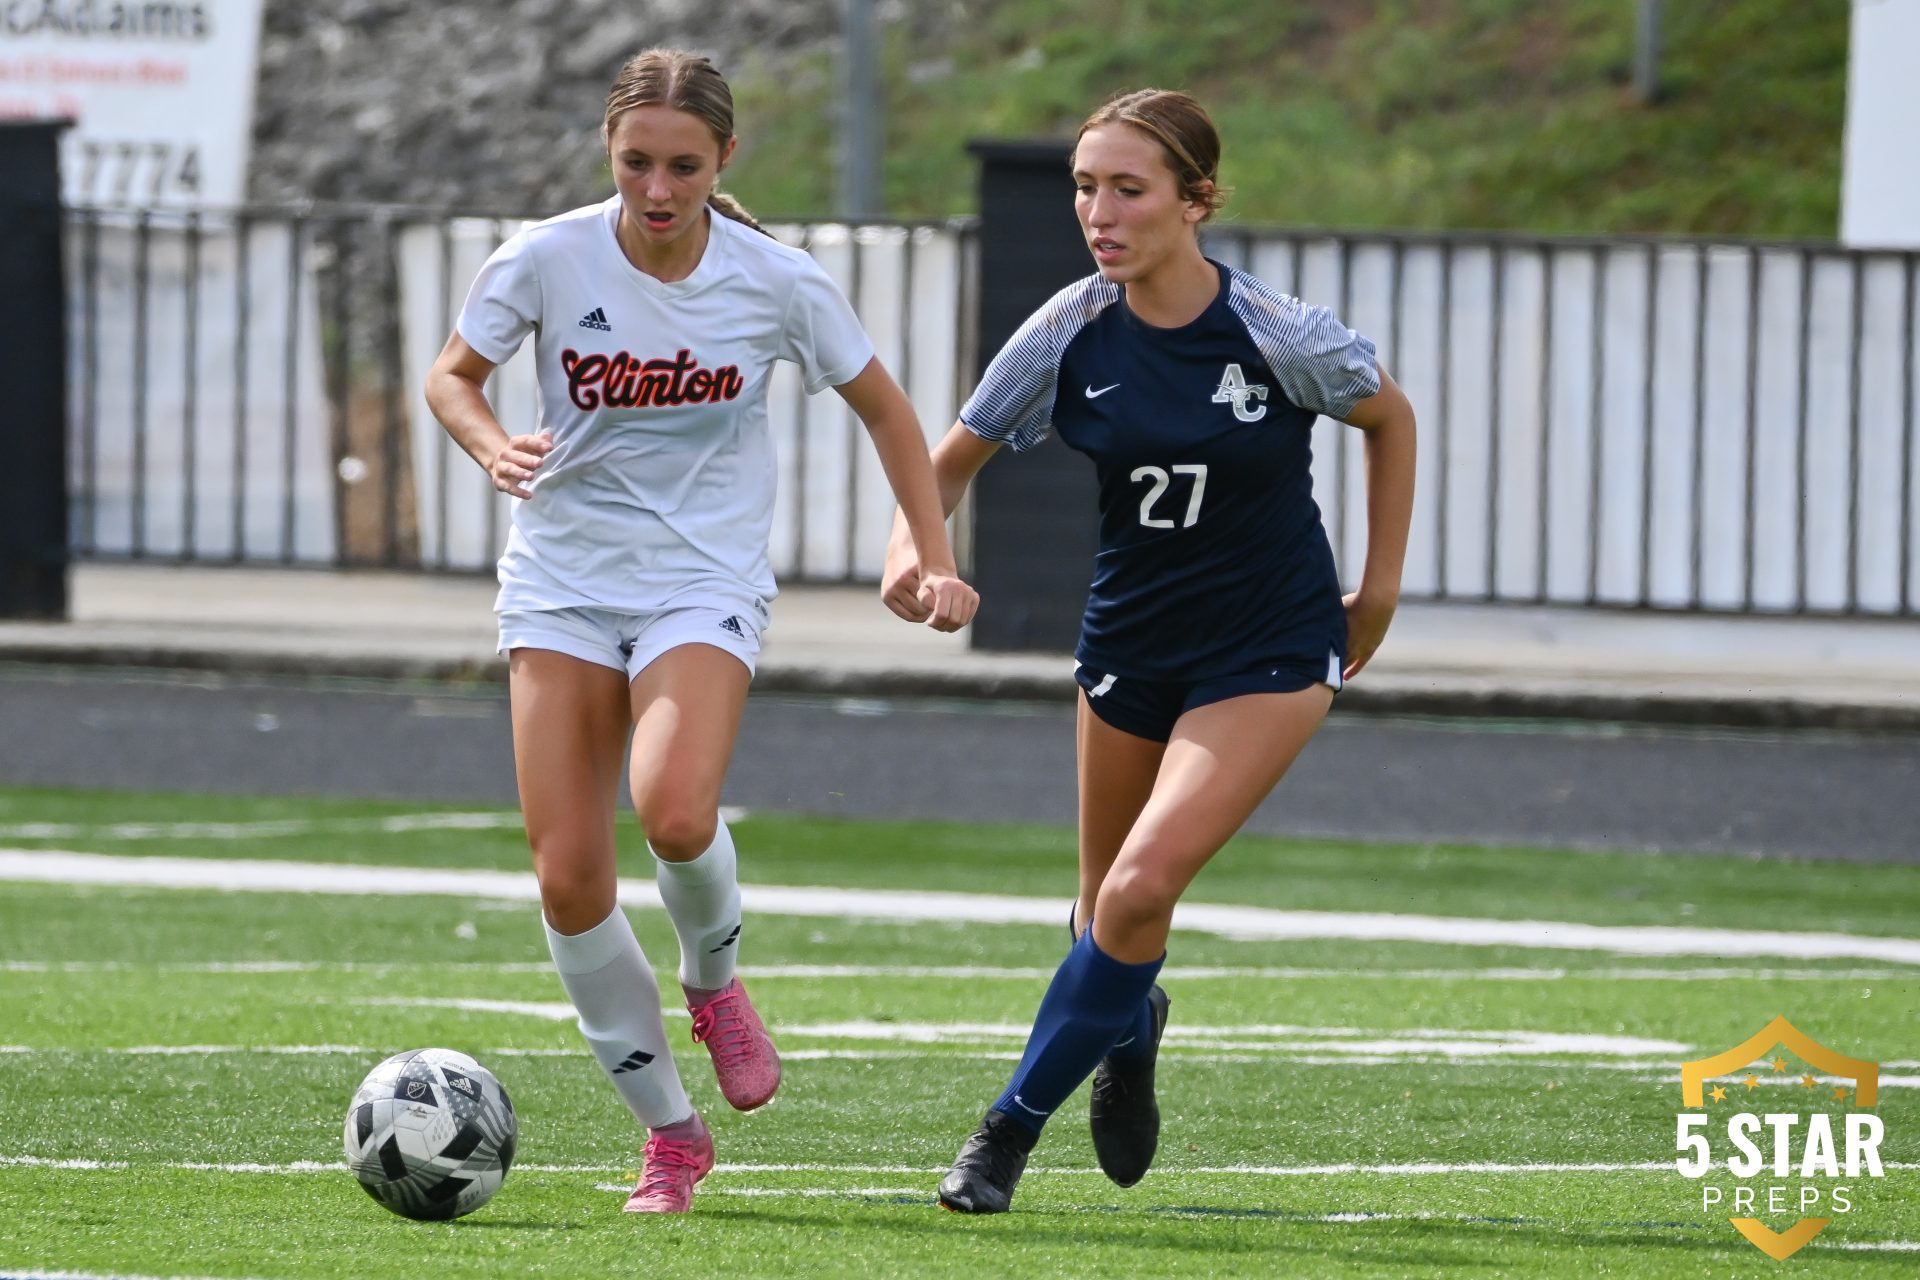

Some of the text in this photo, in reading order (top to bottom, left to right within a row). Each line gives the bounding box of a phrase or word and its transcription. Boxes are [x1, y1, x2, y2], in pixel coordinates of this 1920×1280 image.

[0, 0, 210, 41] cAdams
[80, 139, 202, 205] 7774
[578, 319, 612, 332] adidas
[561, 348, 744, 412] Clinton
[1130, 464, 1208, 529] 27
